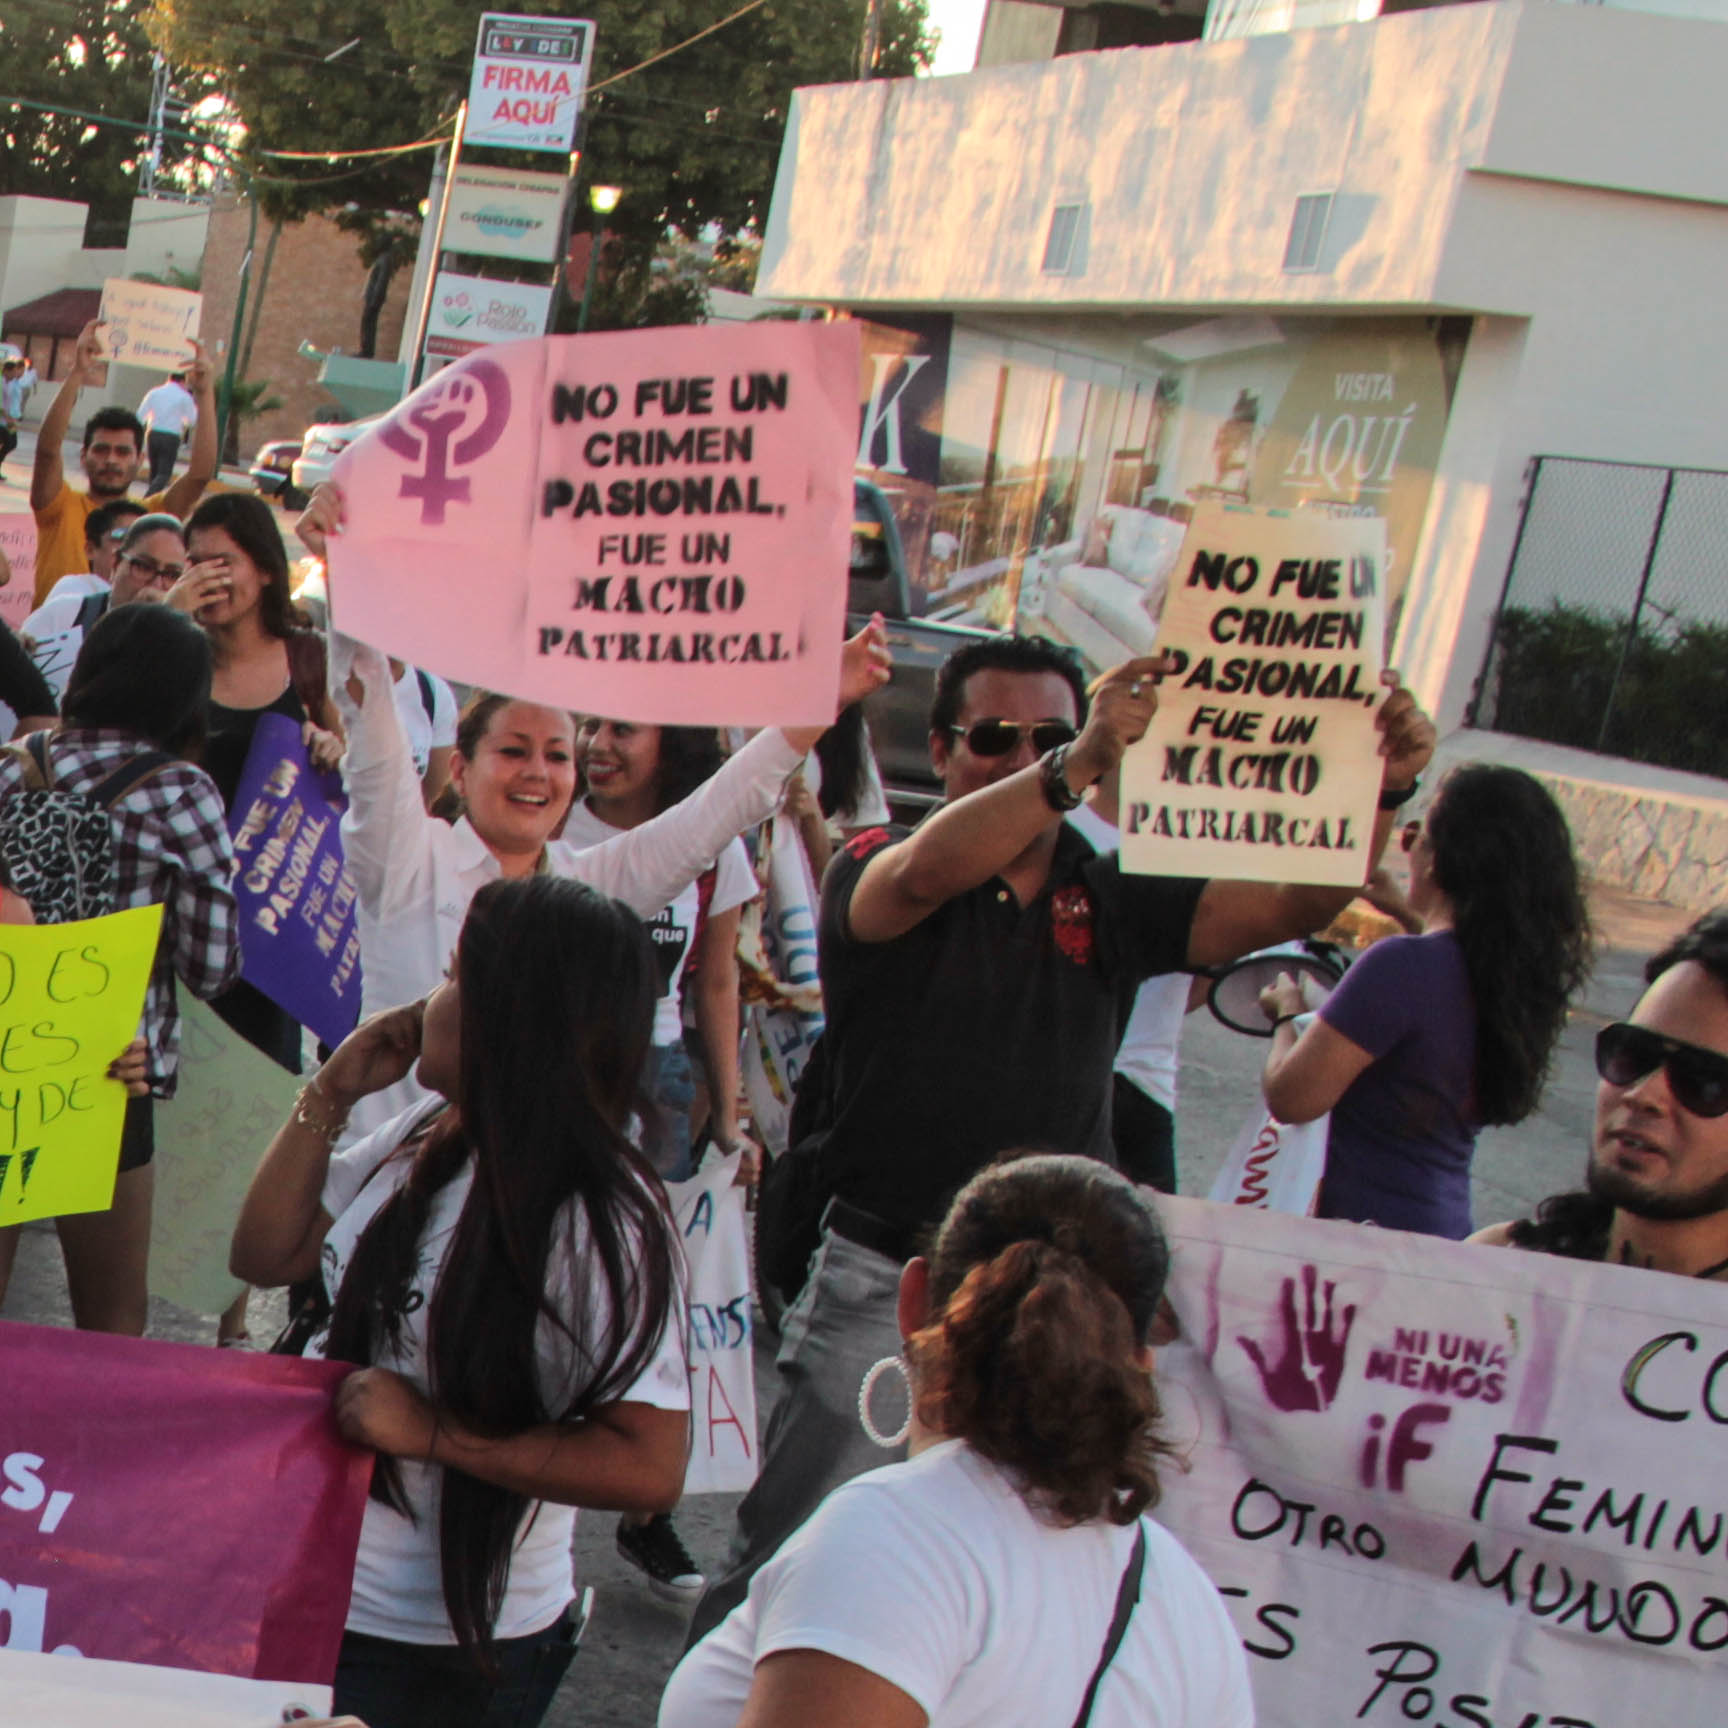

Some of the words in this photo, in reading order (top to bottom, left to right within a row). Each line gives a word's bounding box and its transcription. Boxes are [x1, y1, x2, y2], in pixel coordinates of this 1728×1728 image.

[481, 64, 572, 96] FIRMA
[492, 94, 561, 126] AQUÍ
[551, 381, 618, 425] NO
[634, 375, 714, 418] FUE
[729, 371, 789, 414] UN
[1335, 371, 1395, 401] VISITA
[582, 425, 754, 468] CRIMEN
[1283, 401, 1418, 493] AQUÍ
[541, 475, 787, 520] PASIONAL,
[597, 532, 668, 566] FUE
[680, 531, 732, 565] UN
[572, 574, 747, 616] MACHO
[1187, 549, 1260, 594] NO
[1269, 558, 1341, 600] FUE
[1349, 555, 1376, 598] UN
[537, 626, 792, 664] PATRIARCAL
[1209, 606, 1364, 650] CRIMEN
[1150, 647, 1378, 708] PASIONAL,
[1188, 705, 1263, 742] FUE
[1270, 713, 1320, 745] UN
[1161, 745, 1322, 796] MACHO
[1126, 801, 1355, 850] PATRIARCAL
[651, 926, 686, 946] que
[46, 944, 111, 1004] ES
[37, 1074, 96, 1127] DE
[1393, 1325, 1434, 1359] NI
[1439, 1333, 1509, 1371] UNA
[1364, 1349, 1510, 1405] MENOS
[1471, 1433, 1728, 1558] FEMIN
[1230, 1476, 1389, 1562] OTRO
[1451, 1540, 1728, 1655] MUNDO
